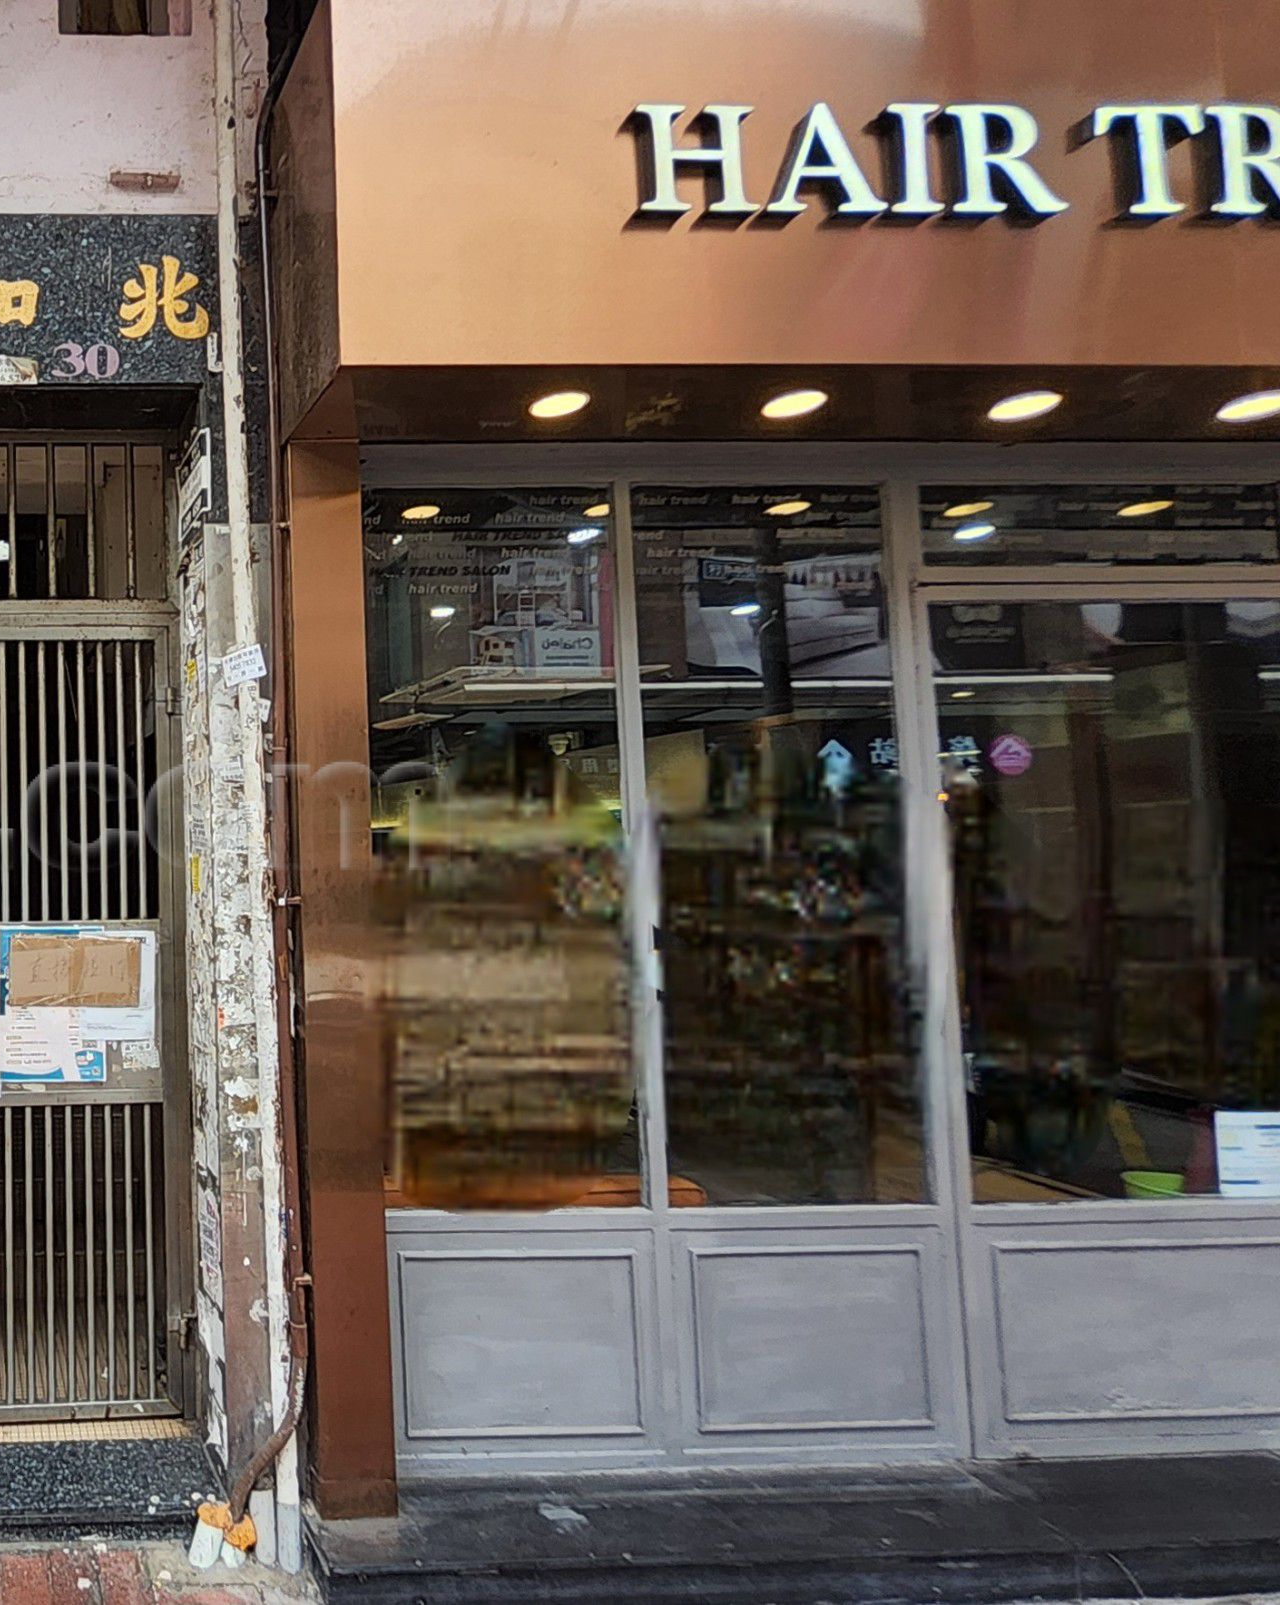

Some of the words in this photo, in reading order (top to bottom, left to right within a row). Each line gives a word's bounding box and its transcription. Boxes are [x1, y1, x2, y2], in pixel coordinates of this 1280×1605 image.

[633, 102, 1070, 214] HAIR
[52, 342, 119, 378] 30
[408, 565, 459, 577] TREND
[461, 565, 511, 576] SALON
[408, 583, 436, 594] hair
[438, 583, 478, 594] trend
